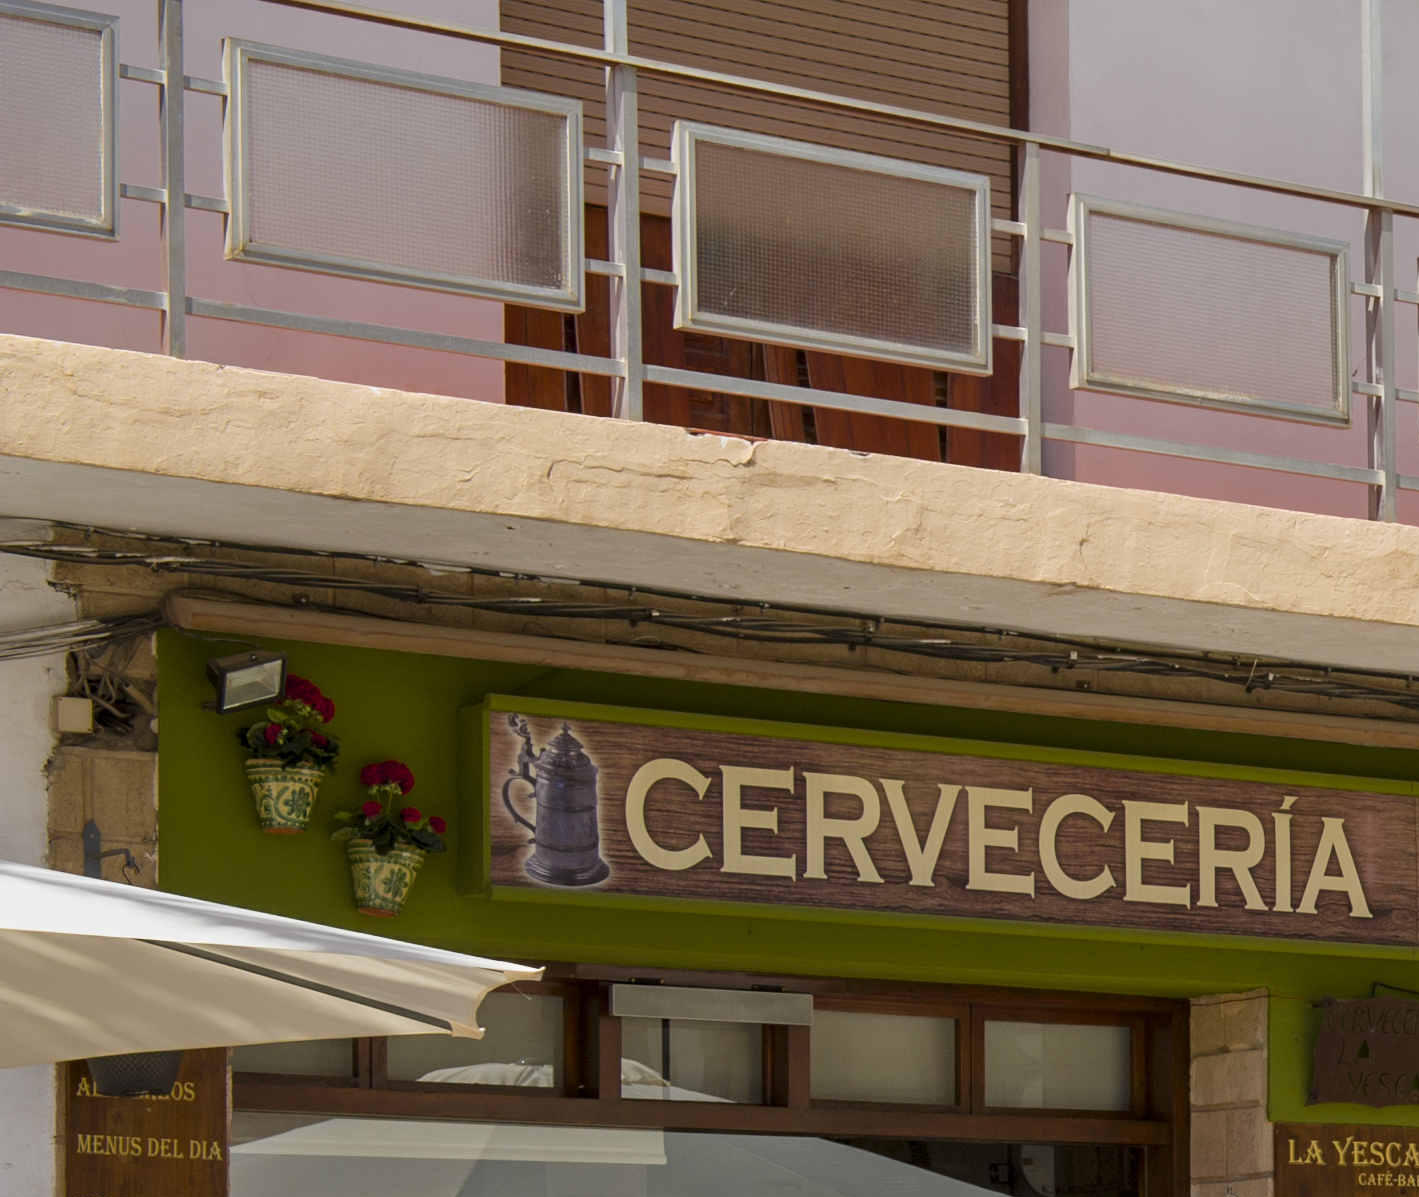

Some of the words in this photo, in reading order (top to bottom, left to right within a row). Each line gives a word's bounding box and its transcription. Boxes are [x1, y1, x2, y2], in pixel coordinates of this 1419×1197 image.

[625, 757, 1374, 919] CERVECERÍA
[76, 1133, 142, 1157] MENUS
[147, 1137, 185, 1159] DEL
[189, 1139, 223, 1161] DIA
[1288, 1139, 1326, 1166] LA
